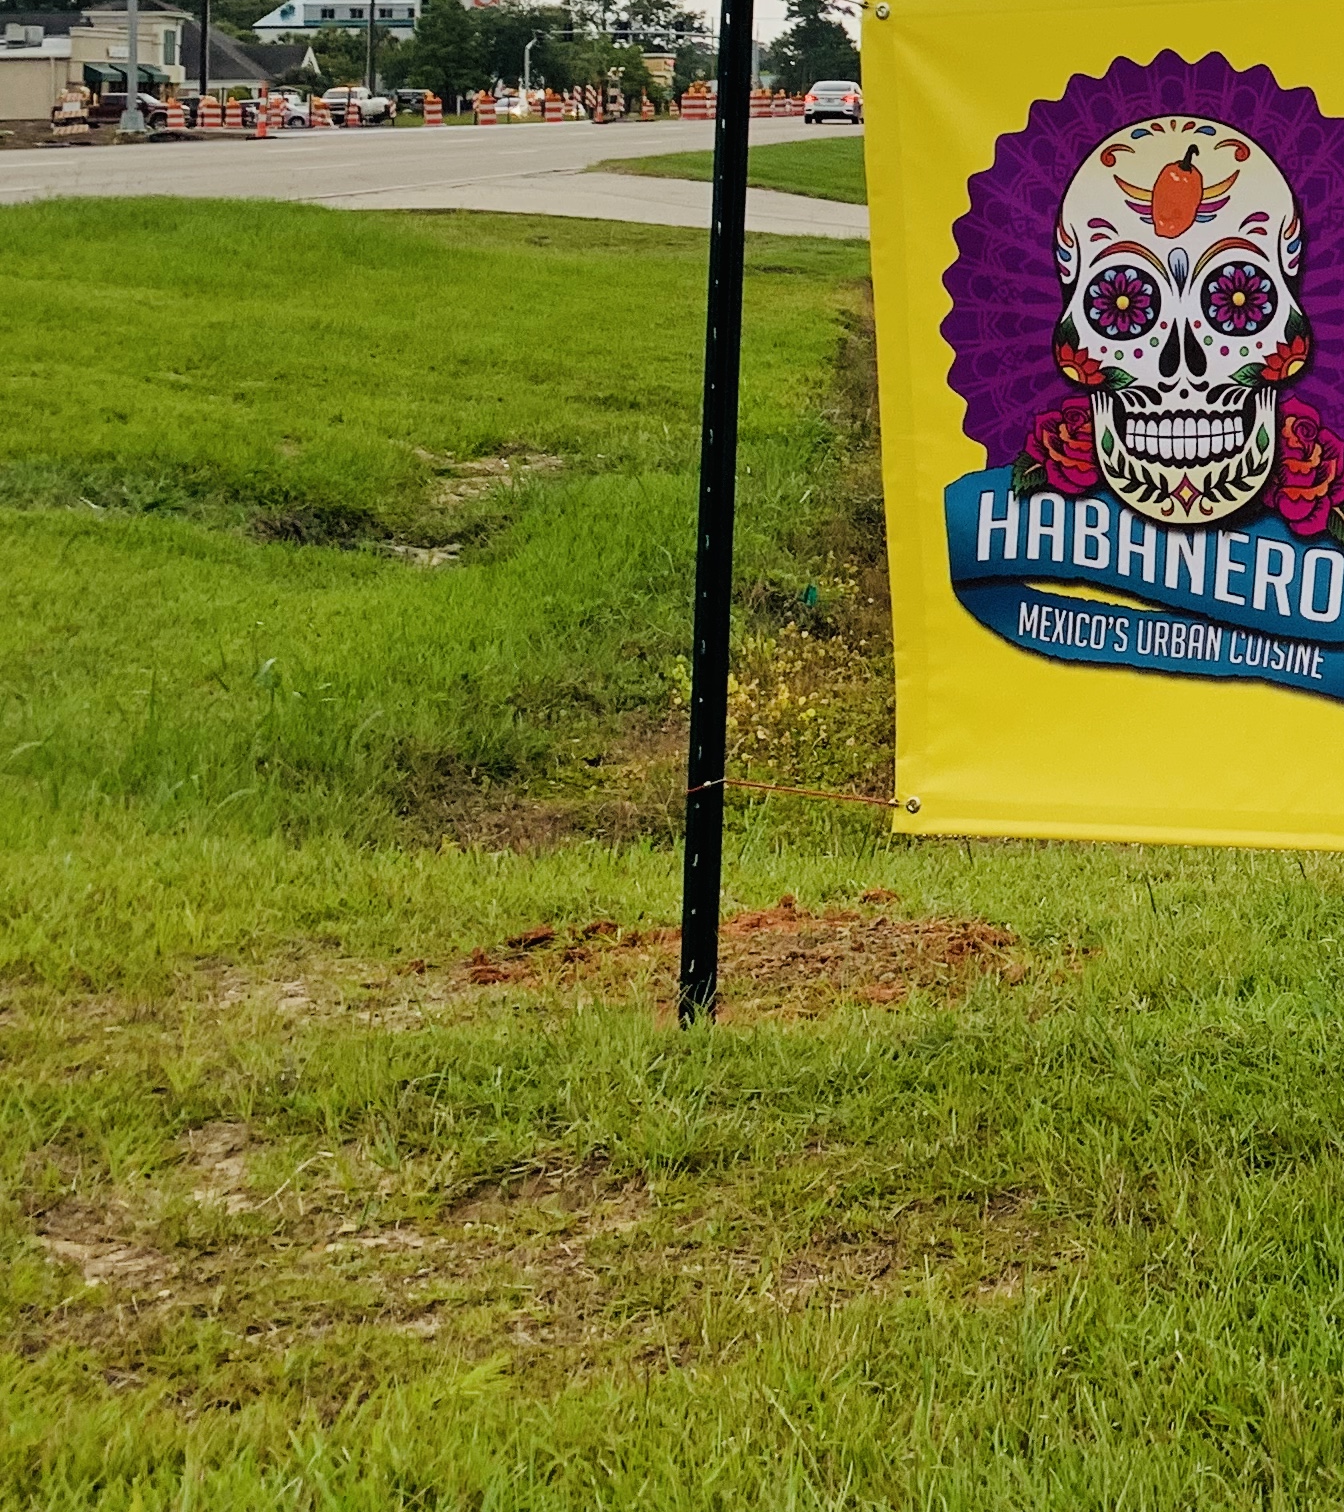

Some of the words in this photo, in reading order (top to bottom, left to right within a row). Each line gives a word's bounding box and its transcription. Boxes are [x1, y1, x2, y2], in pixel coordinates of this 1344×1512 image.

[1017, 600, 1129, 654] MEXICO'S
[1136, 618, 1222, 663] URBAN
[1227, 628, 1325, 680] CUISINE
